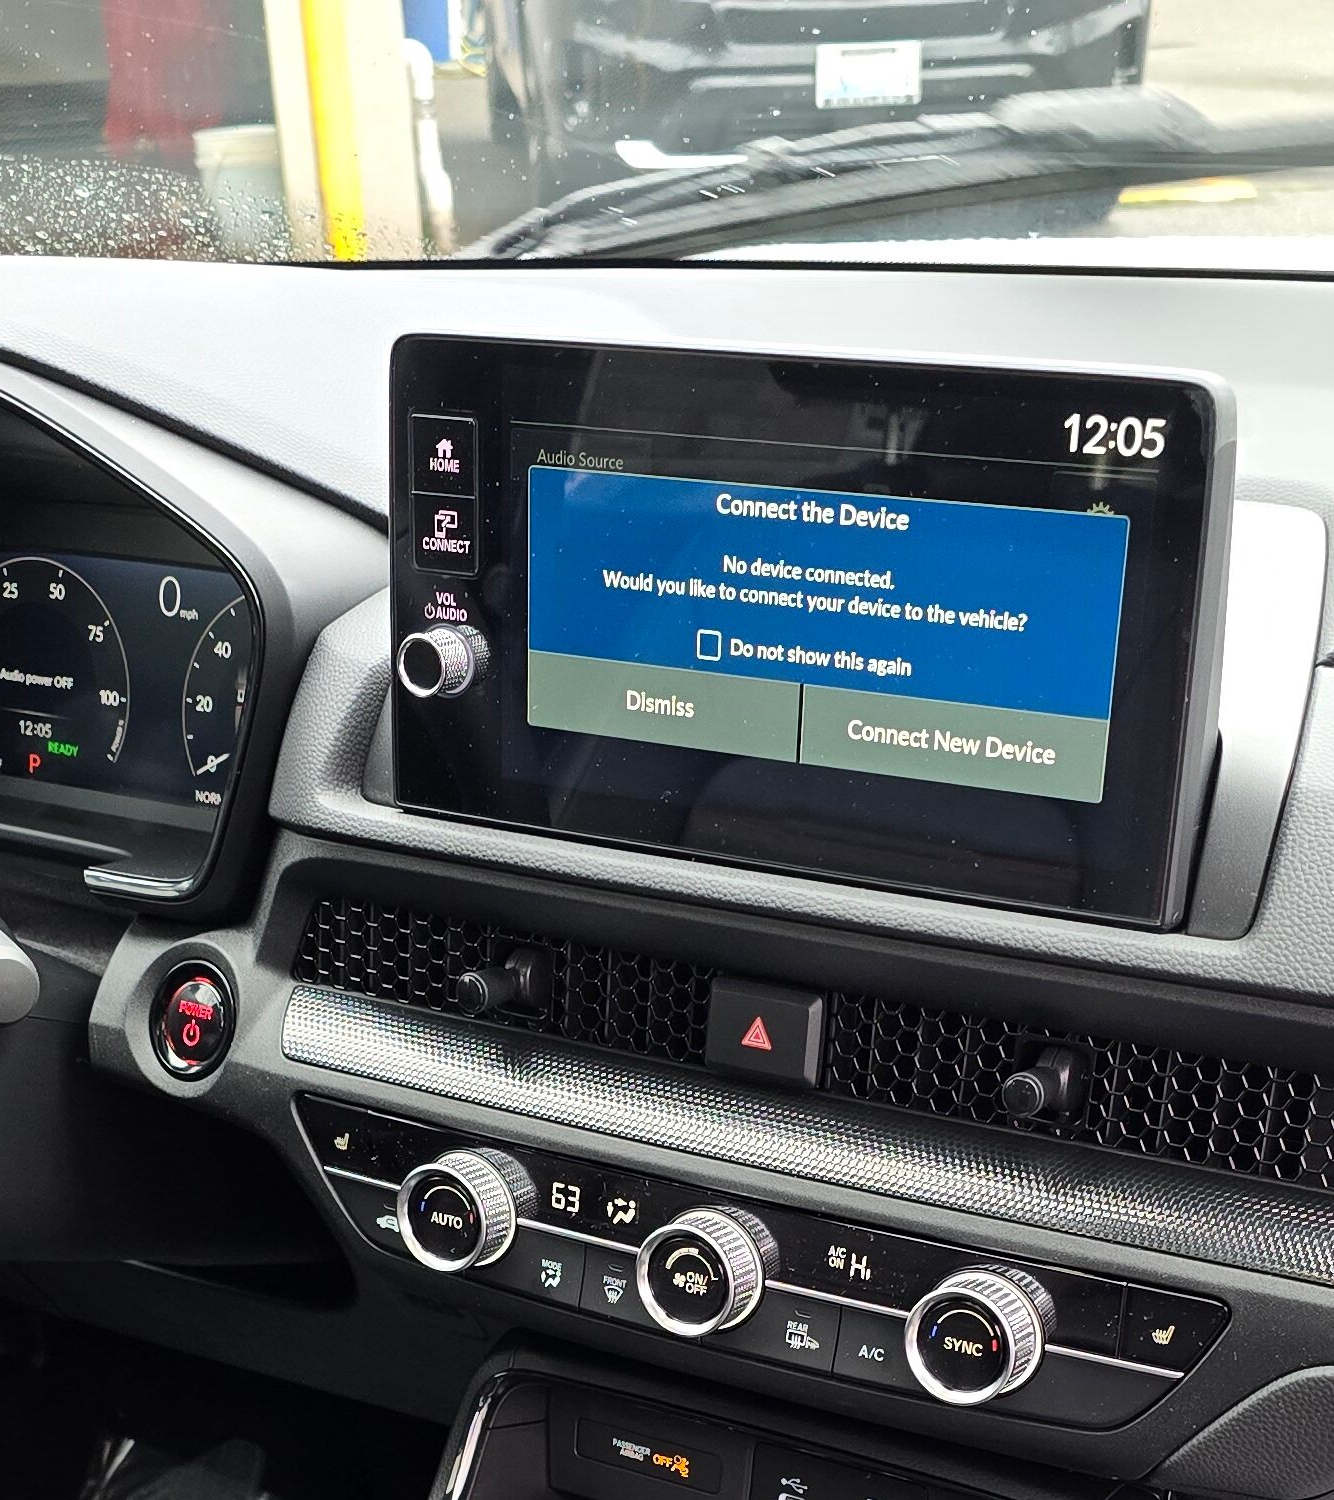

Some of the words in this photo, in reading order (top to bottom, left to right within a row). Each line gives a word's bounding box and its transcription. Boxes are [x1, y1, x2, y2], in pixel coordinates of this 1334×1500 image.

[1064, 413, 1167, 459] 12:05
[429, 457, 460, 473] HOME
[537, 449, 575, 466] Audio
[579, 452, 624, 470] Source
[716, 493, 798, 521] Connect
[801, 501, 835, 524] the
[839, 504, 910, 531] Device
[422, 537, 470, 553] CONNECT
[723, 555, 747, 574] No
[751, 558, 802, 580] device
[805, 565, 896, 590] connected.
[3, 582, 18, 599] 25
[49, 583, 65, 600] 50
[159, 576, 181, 617] 0
[435, 591, 457, 607] VOL
[602, 569, 654, 592] Would
[656, 577, 686, 596] you
[689, 577, 716, 598] like
[719, 582, 737, 600] to
[739, 586, 804, 609] connect
[806, 593, 845, 613] your
[847, 596, 901, 619] device
[905, 602, 923, 622] to
[927, 603, 956, 625] the
[959, 608, 1028, 632] vehicle?
[180, 608, 198, 621] mph
[436, 607, 467, 622] AUDIO
[88, 625, 103, 642] 75
[213, 641, 231, 659] 40
[730, 638, 754, 657] Do
[756, 643, 785, 662] not
[786, 645, 832, 668] show
[833, 649, 864, 671] this
[867, 656, 912, 677] again
[0, 668, 25, 683] Audio
[26, 673, 53, 687] power
[53, 675, 73, 689] OFF
[99, 690, 119, 706] 100
[195, 695, 213, 713] 20
[626, 689, 695, 718] Dismiss
[19, 720, 52, 738] 12:05
[47, 741, 78, 757] READY
[846, 720, 929, 750] Connect
[933, 729, 980, 756] New
[984, 736, 1057, 766] Device
[29, 754, 41, 774] P
[178, 1000, 214, 1020] POWER
[551, 1181, 581, 1213] 63
[430, 1209, 463, 1230] AUTO
[828, 1245, 847, 1258] A/C
[541, 1258, 563, 1272] MODE
[828, 1256, 845, 1270] ON
[602, 1275, 627, 1289] FRONT
[686, 1271, 709, 1285] ON/
[685, 1282, 708, 1296] OFF
[786, 1320, 809, 1332] REAR
[858, 1344, 885, 1361] A/C
[943, 1336, 984, 1357] SYNC
[652, 1453, 673, 1468] OFF
